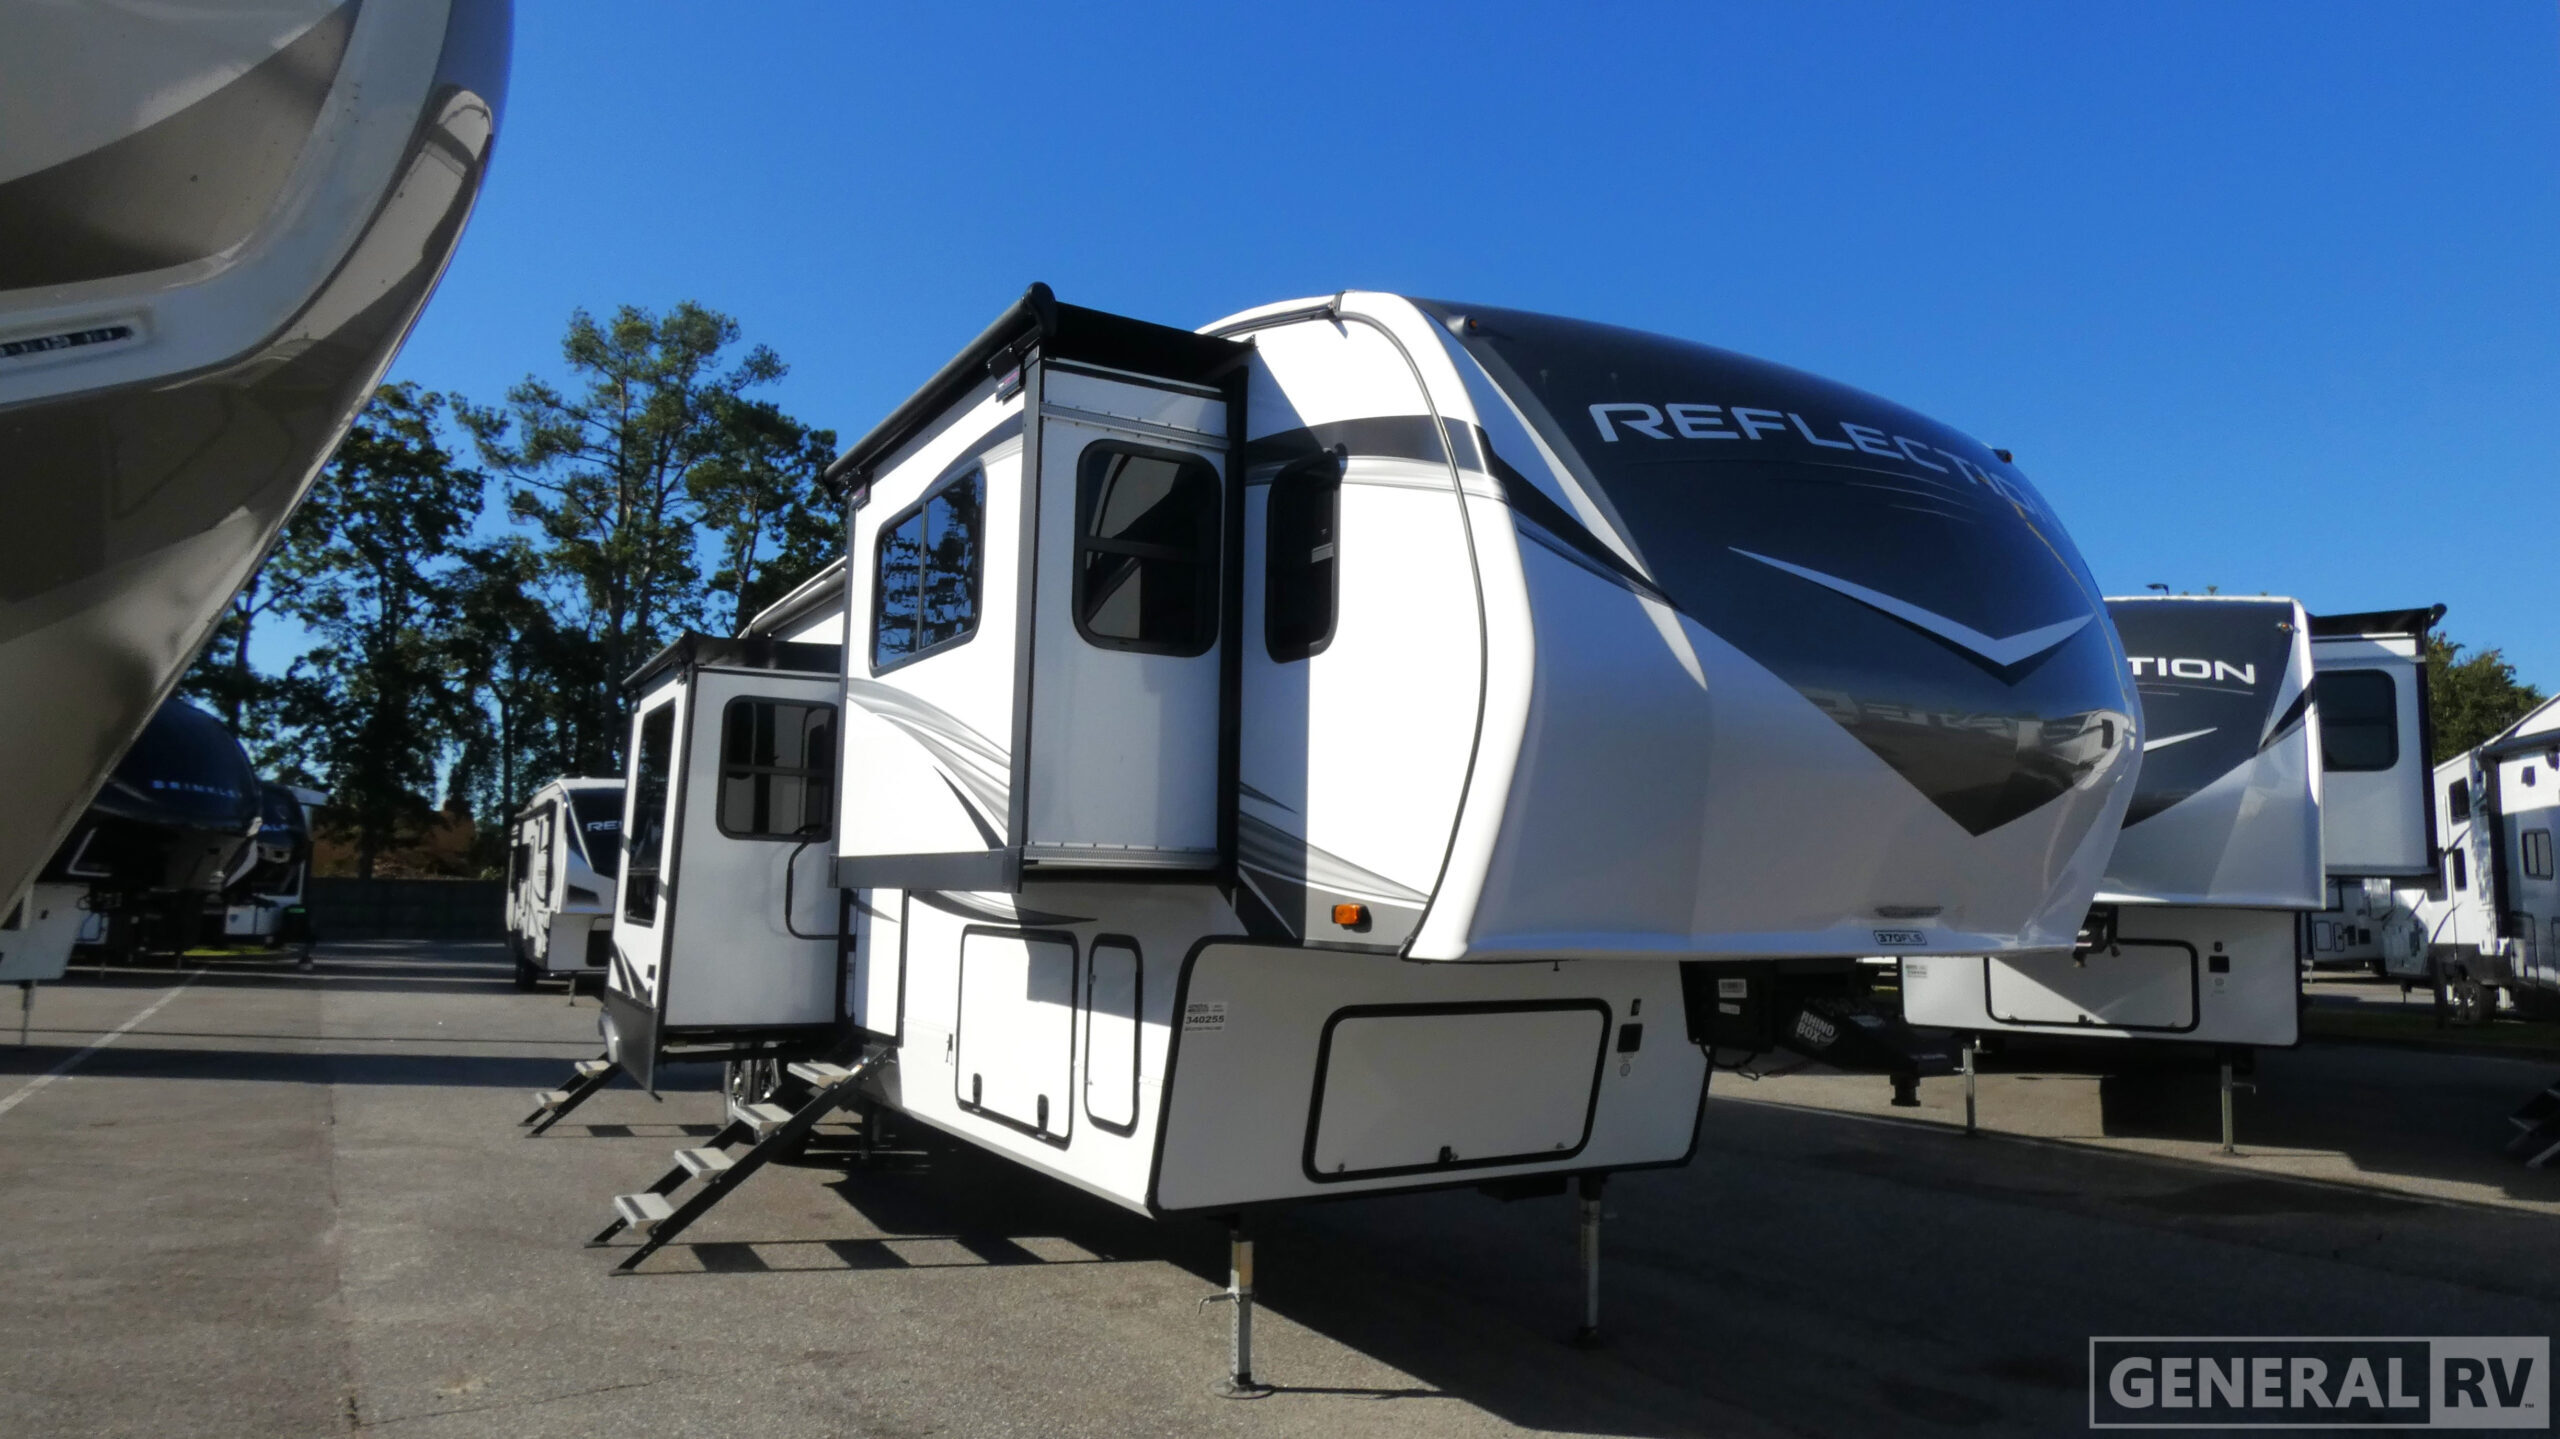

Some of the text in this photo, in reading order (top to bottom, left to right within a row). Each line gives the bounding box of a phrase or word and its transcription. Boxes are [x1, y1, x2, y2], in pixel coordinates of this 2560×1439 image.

[1185, 1014, 1225, 1025] 340255
[1799, 1009, 1836, 1037] RHINO
[1796, 1021, 1822, 1044] BOX
